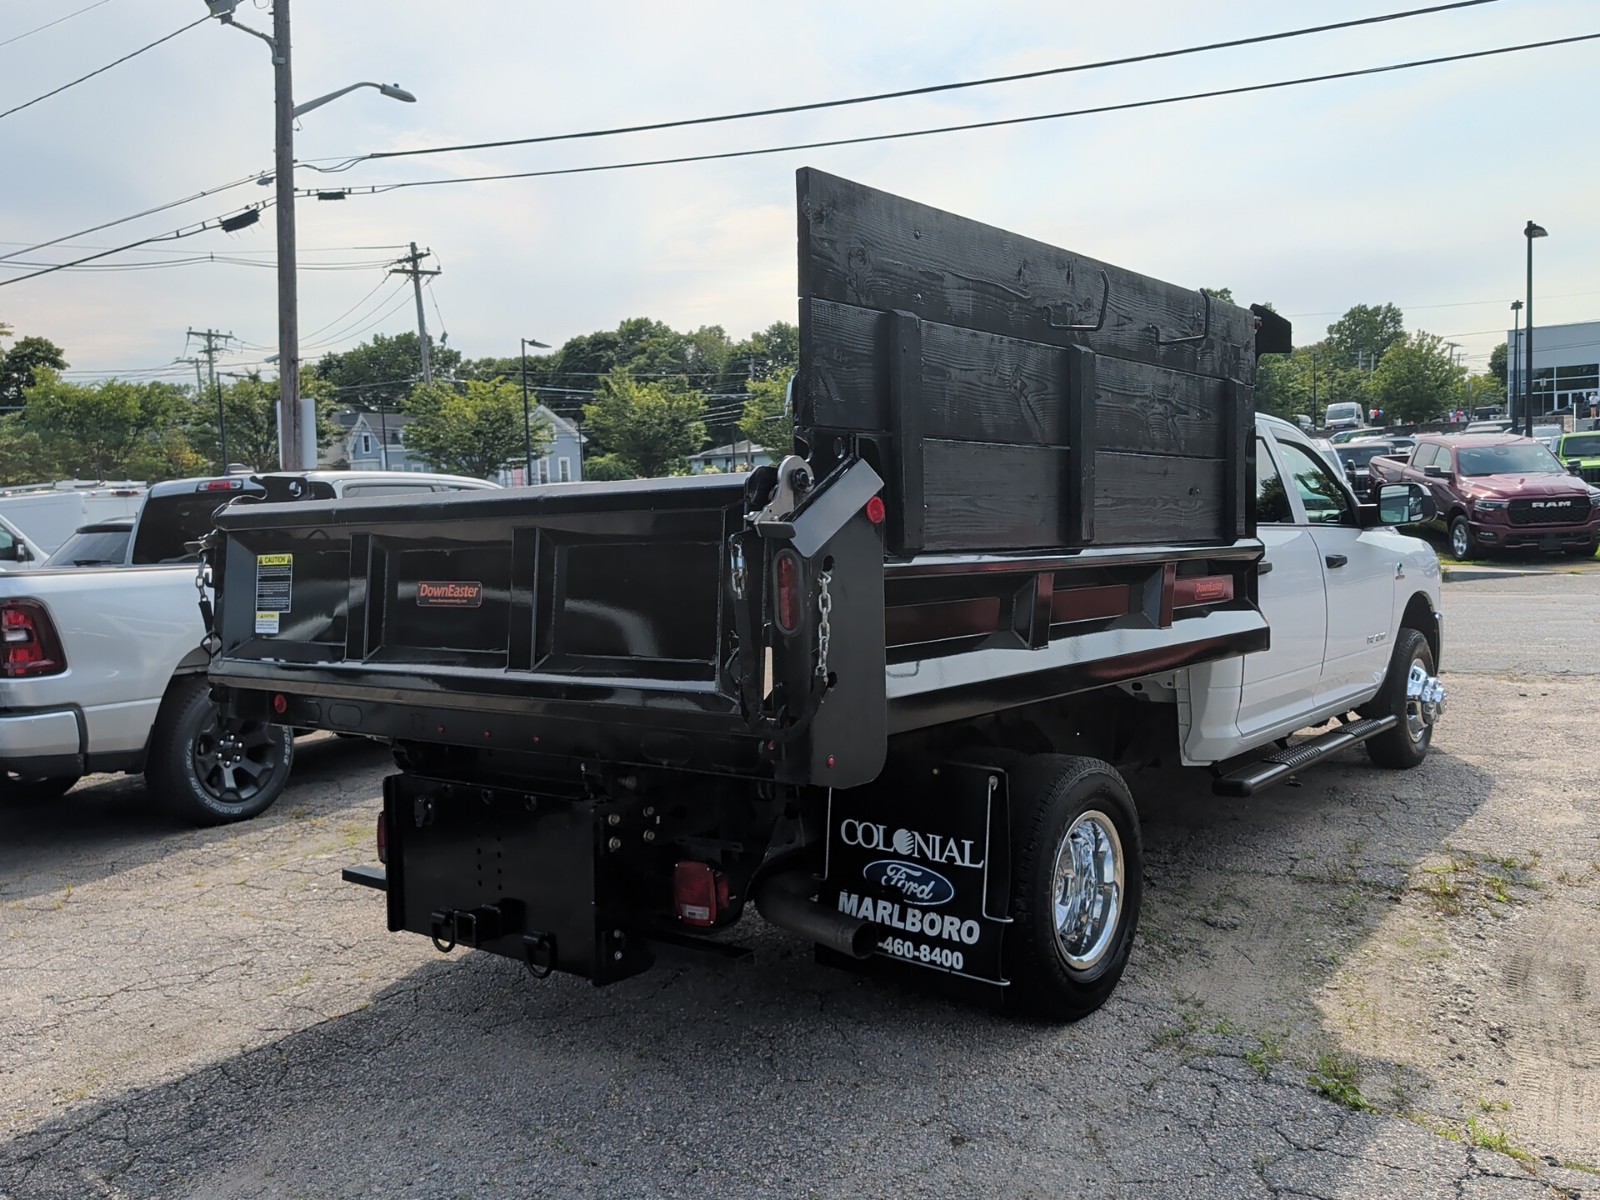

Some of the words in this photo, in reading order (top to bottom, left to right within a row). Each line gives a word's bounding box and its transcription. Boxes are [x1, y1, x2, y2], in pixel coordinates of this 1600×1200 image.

[264, 556, 286, 564] CAUTION
[420, 584, 479, 597] DownEaster
[840, 818, 984, 869] COLONIAL
[881, 863, 936, 900] Ford
[838, 890, 980, 945] MARLBORO
